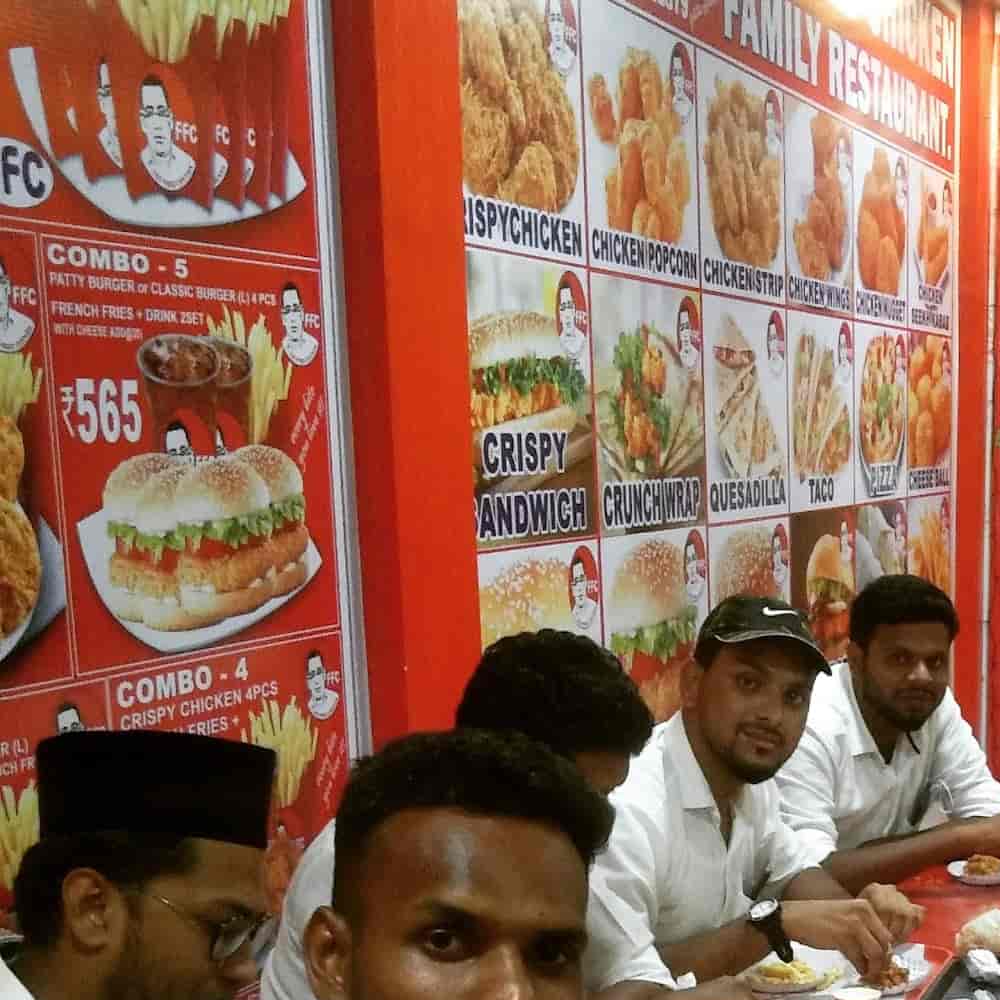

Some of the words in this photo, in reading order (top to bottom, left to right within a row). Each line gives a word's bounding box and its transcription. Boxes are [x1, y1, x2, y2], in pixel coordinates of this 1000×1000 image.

[175, 120, 198, 144] FFC
[48, 242, 150, 274] COMBO
[175, 258, 189, 278] 5
[592, 229, 645, 266] CHICKEN
[648, 242, 698, 280] POPCORN
[49, 271, 84, 288] PATTY
[88, 275, 134, 293] BURGER
[150, 282, 194, 298] CLASSIC
[196, 287, 236, 305] BURGER
[703, 258, 751, 291] CHICKEN
[755, 271, 783, 297] STRIP
[788, 275, 824, 305] CHICKEN
[825, 285, 850, 310] WINGS
[13, 287, 37, 305] FFC
[52, 301, 99, 318] FRENCH
[102, 304, 134, 320] FRIES
[145, 308, 176, 323] DRINK
[483, 432, 567, 475] CRISPY
[604, 483, 661, 527] CRUNCH
[664, 479, 700, 521] WRAP
[710, 478, 786, 512] QUESADILLA
[808, 477, 834, 504] TACO
[117, 665, 212, 709] COMBO
[235, 657, 249, 681] 4
[121, 704, 176, 731] CRISPY
[180, 691, 242, 717] CHICKEN
[246, 680, 279, 701] 4PCS
[188, 716, 229, 736] FRIES
[21, 756, 36, 773] FR
